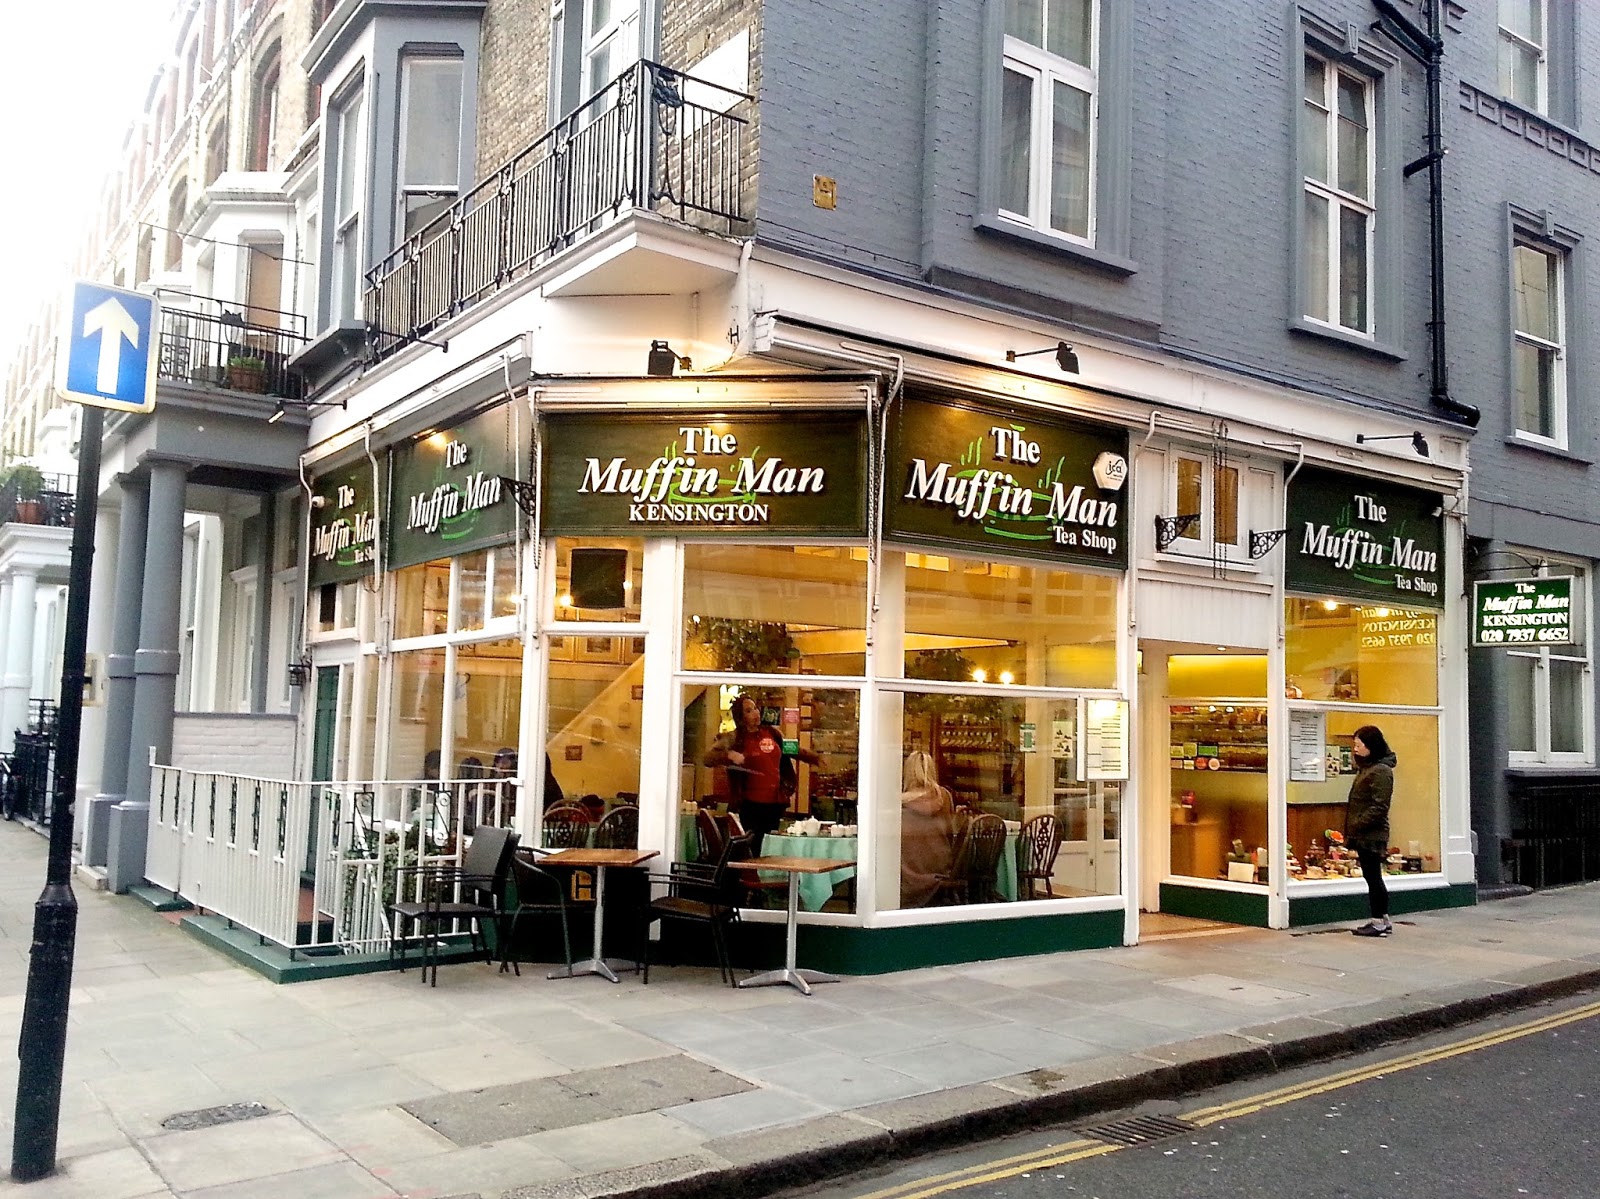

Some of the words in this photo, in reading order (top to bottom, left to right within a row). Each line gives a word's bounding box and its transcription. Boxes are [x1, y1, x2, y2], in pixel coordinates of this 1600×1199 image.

[445, 440, 468, 468] The
[679, 427, 737, 454] The
[991, 426, 1041, 464] The
[577, 456, 718, 503] Muffin
[730, 457, 825, 494] Man
[904, 458, 1033, 520] Muffin
[1045, 482, 1118, 528] Man
[337, 484, 355, 509] The
[406, 483, 459, 534] Muffin
[461, 471, 501, 512] Man
[1354, 494, 1387, 523] The
[628, 504, 769, 522] KENSINGTON
[312, 518, 350, 561] Muffin
[1053, 525, 1077, 546] Tea
[1081, 530, 1117, 554] Shop
[1299, 521, 1383, 569] Muffin
[1390, 536, 1437, 573] Man
[1395, 573, 1412, 591] Tea
[1414, 577, 1437, 598] Shop
[1515, 583, 1536, 594] The
[1482, 595, 1533, 614] Muffin
[1535, 594, 1569, 609] Man
[1483, 612, 1568, 627] KENSINGTON
[1481, 629, 1504, 642] 020
[1506, 628, 1536, 642] 7937
[1537, 627, 1568, 641] 6652
